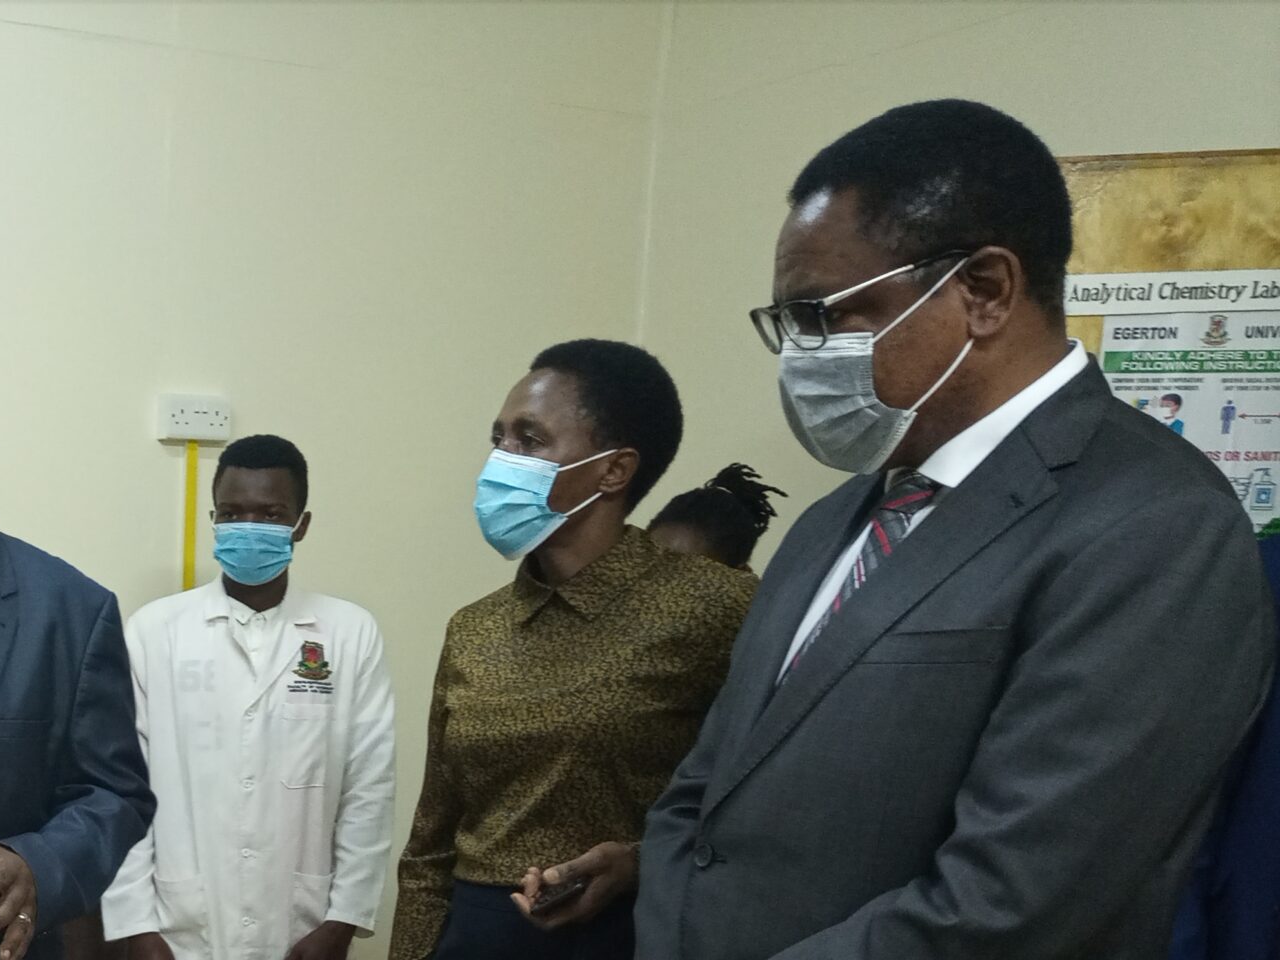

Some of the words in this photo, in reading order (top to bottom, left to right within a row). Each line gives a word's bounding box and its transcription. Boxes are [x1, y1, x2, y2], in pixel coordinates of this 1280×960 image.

[1068, 283, 1153, 304] Analytical
[1158, 282, 1247, 303] Chemistry
[1113, 326, 1178, 340] EGERTON
[1132, 351, 1184, 361] KINDLY
[1187, 351, 1245, 361] ADHERE
[1248, 351, 1268, 360] TO
[1121, 361, 1201, 370] FOLLOWING
